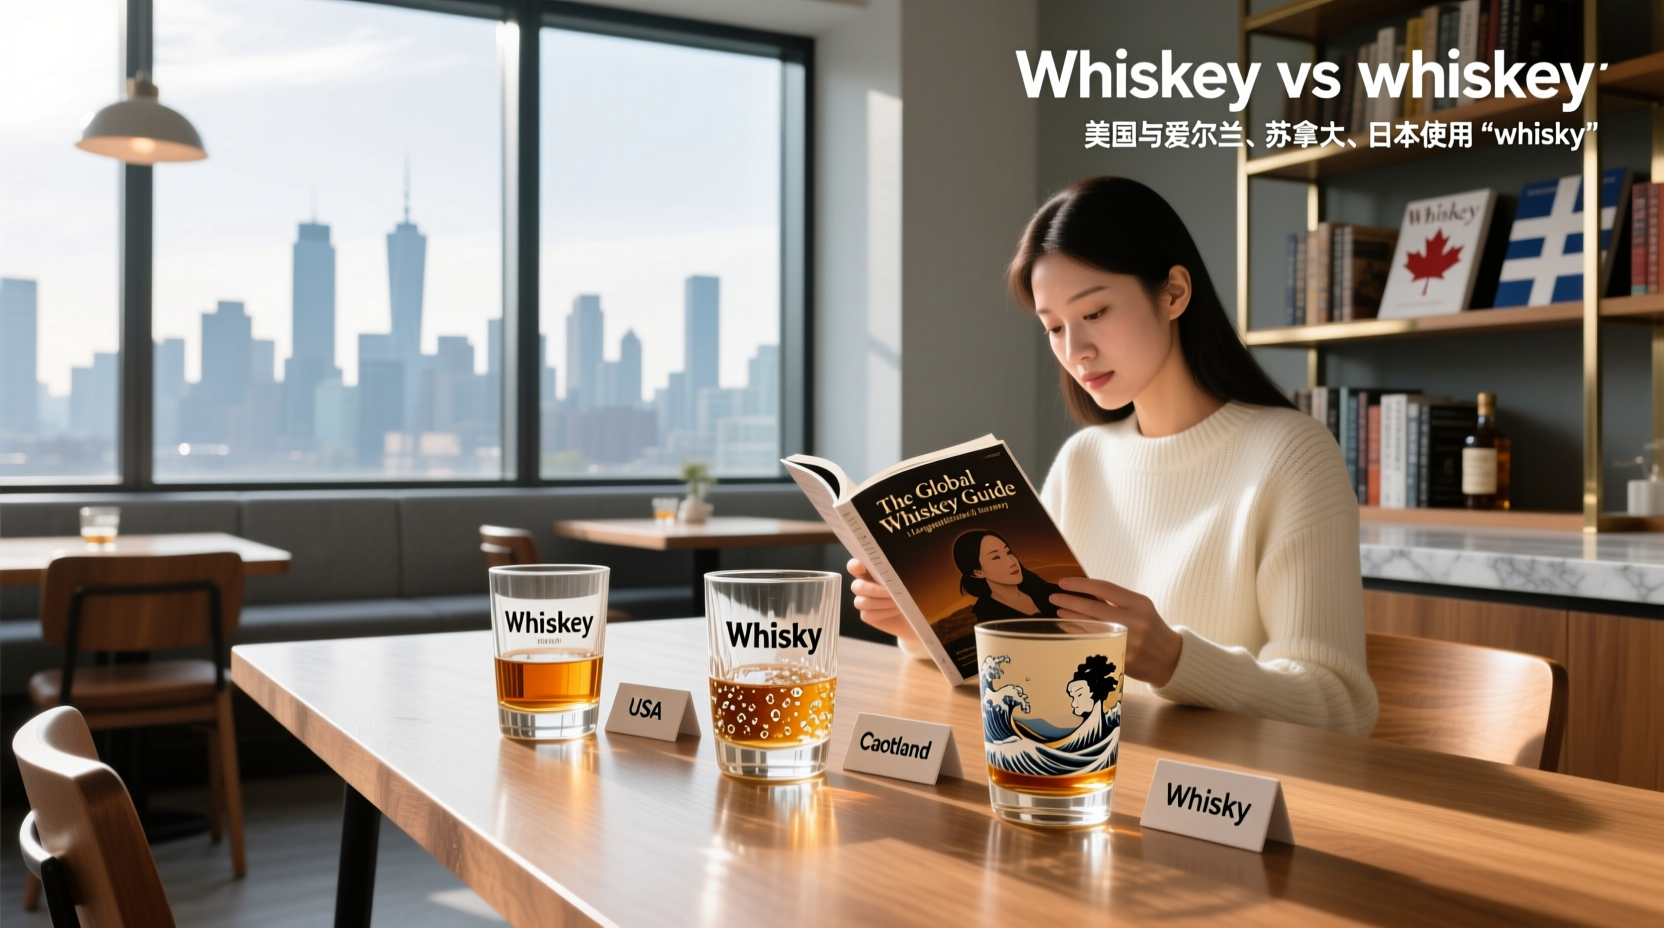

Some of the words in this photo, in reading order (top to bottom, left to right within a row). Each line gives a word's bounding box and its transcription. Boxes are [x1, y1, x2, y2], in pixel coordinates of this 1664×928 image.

[1409, 202, 1480, 226] Whiskey
[915, 469, 976, 498] Global
[879, 497, 958, 534] Whiskey
[961, 480, 1017, 504] Guide
[504, 610, 594, 639] Whiskey
[726, 621, 823, 655] Whisky
[628, 697, 662, 721] USA
[859, 731, 932, 761] Caotland
[1166, 782, 1252, 826] Whisky
